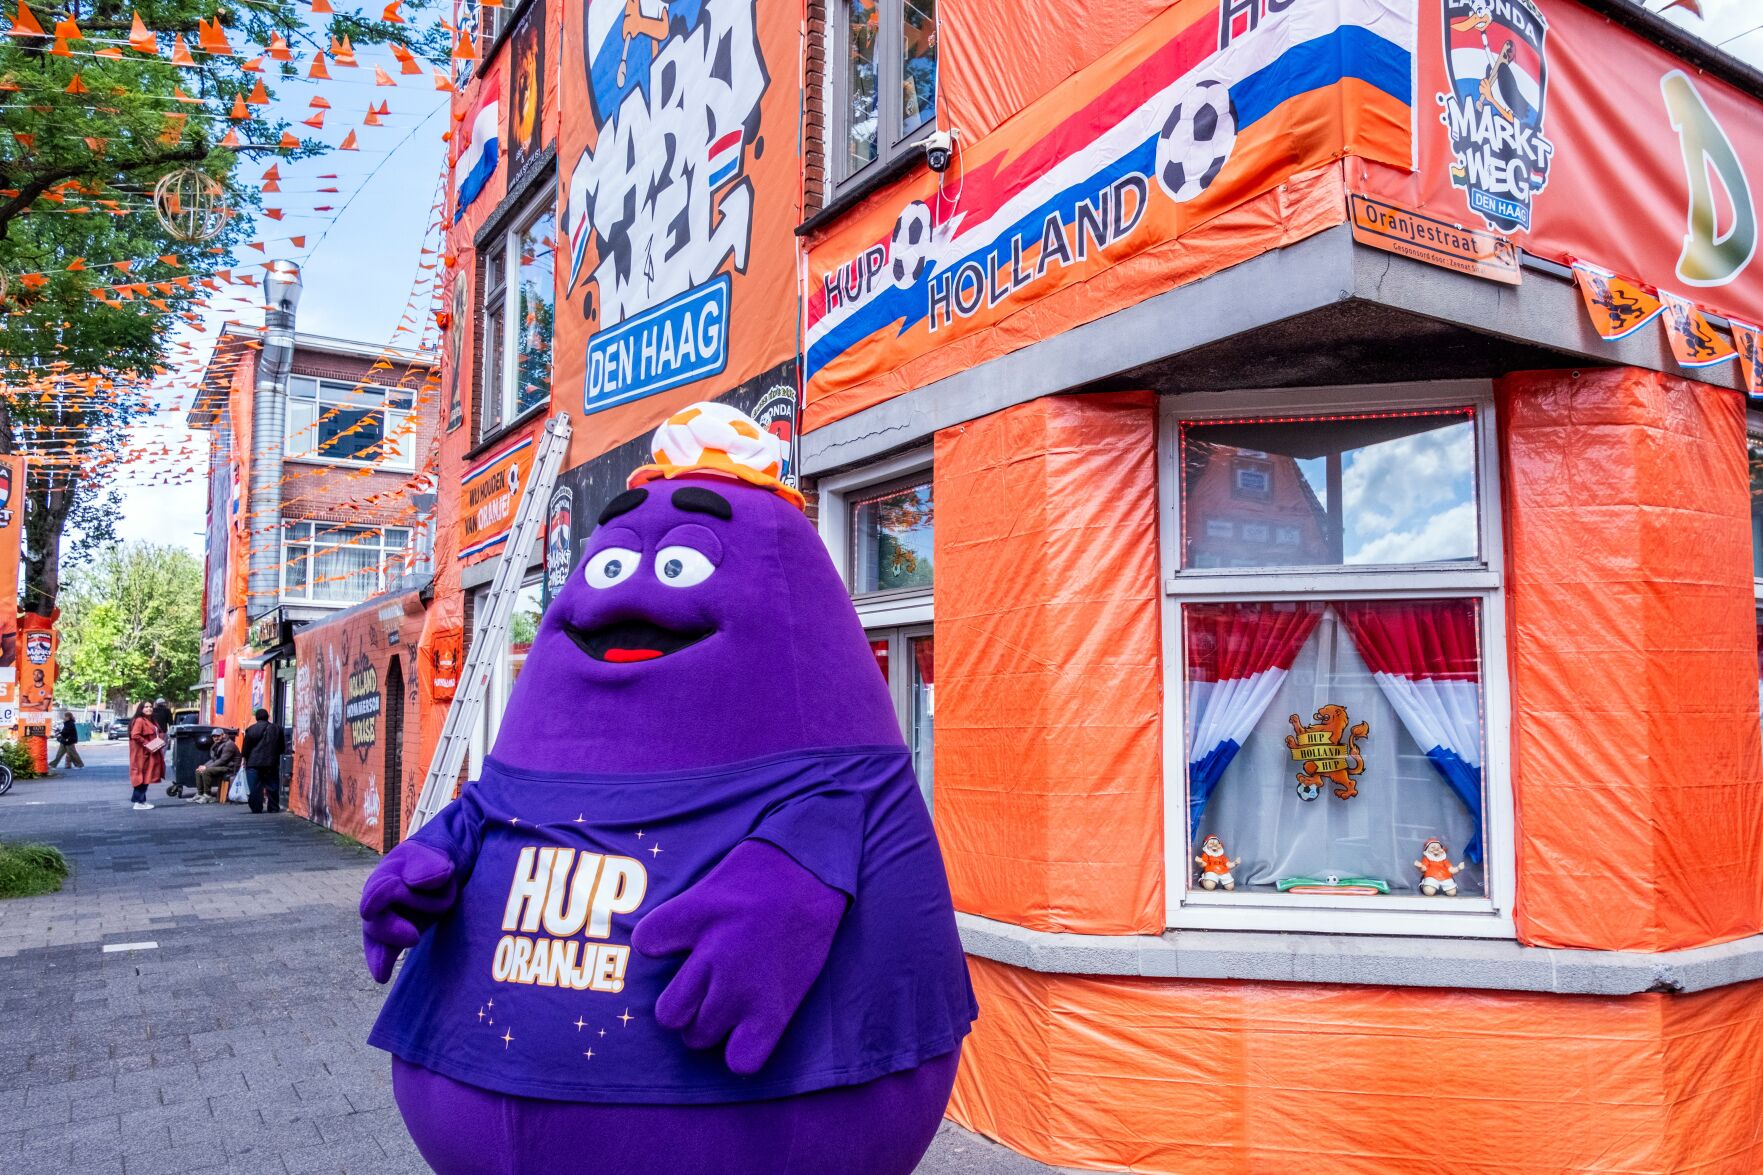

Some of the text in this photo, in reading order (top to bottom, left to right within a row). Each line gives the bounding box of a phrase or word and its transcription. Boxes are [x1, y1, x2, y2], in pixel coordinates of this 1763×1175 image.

[1447, 96, 1552, 167] MARKT
[1466, 144, 1529, 203] WEG
[1366, 204, 1479, 254] Oranjestraat
[1476, 193, 1528, 222] DEN HAAG
[824, 173, 1149, 332] HUP HOLLAND
[589, 300, 720, 398] DEN HAAG
[480, 469, 505, 503] HOUDEN
[465, 493, 511, 536] VAN ORANJE!
[352, 717, 376, 746] HOUSE
[1300, 748, 1341, 759] HOLLAND
[1307, 733, 1325, 743] HUP
[1322, 761, 1340, 770] HUP
[502, 847, 647, 939] HUP
[492, 935, 630, 993] ORANJE!
